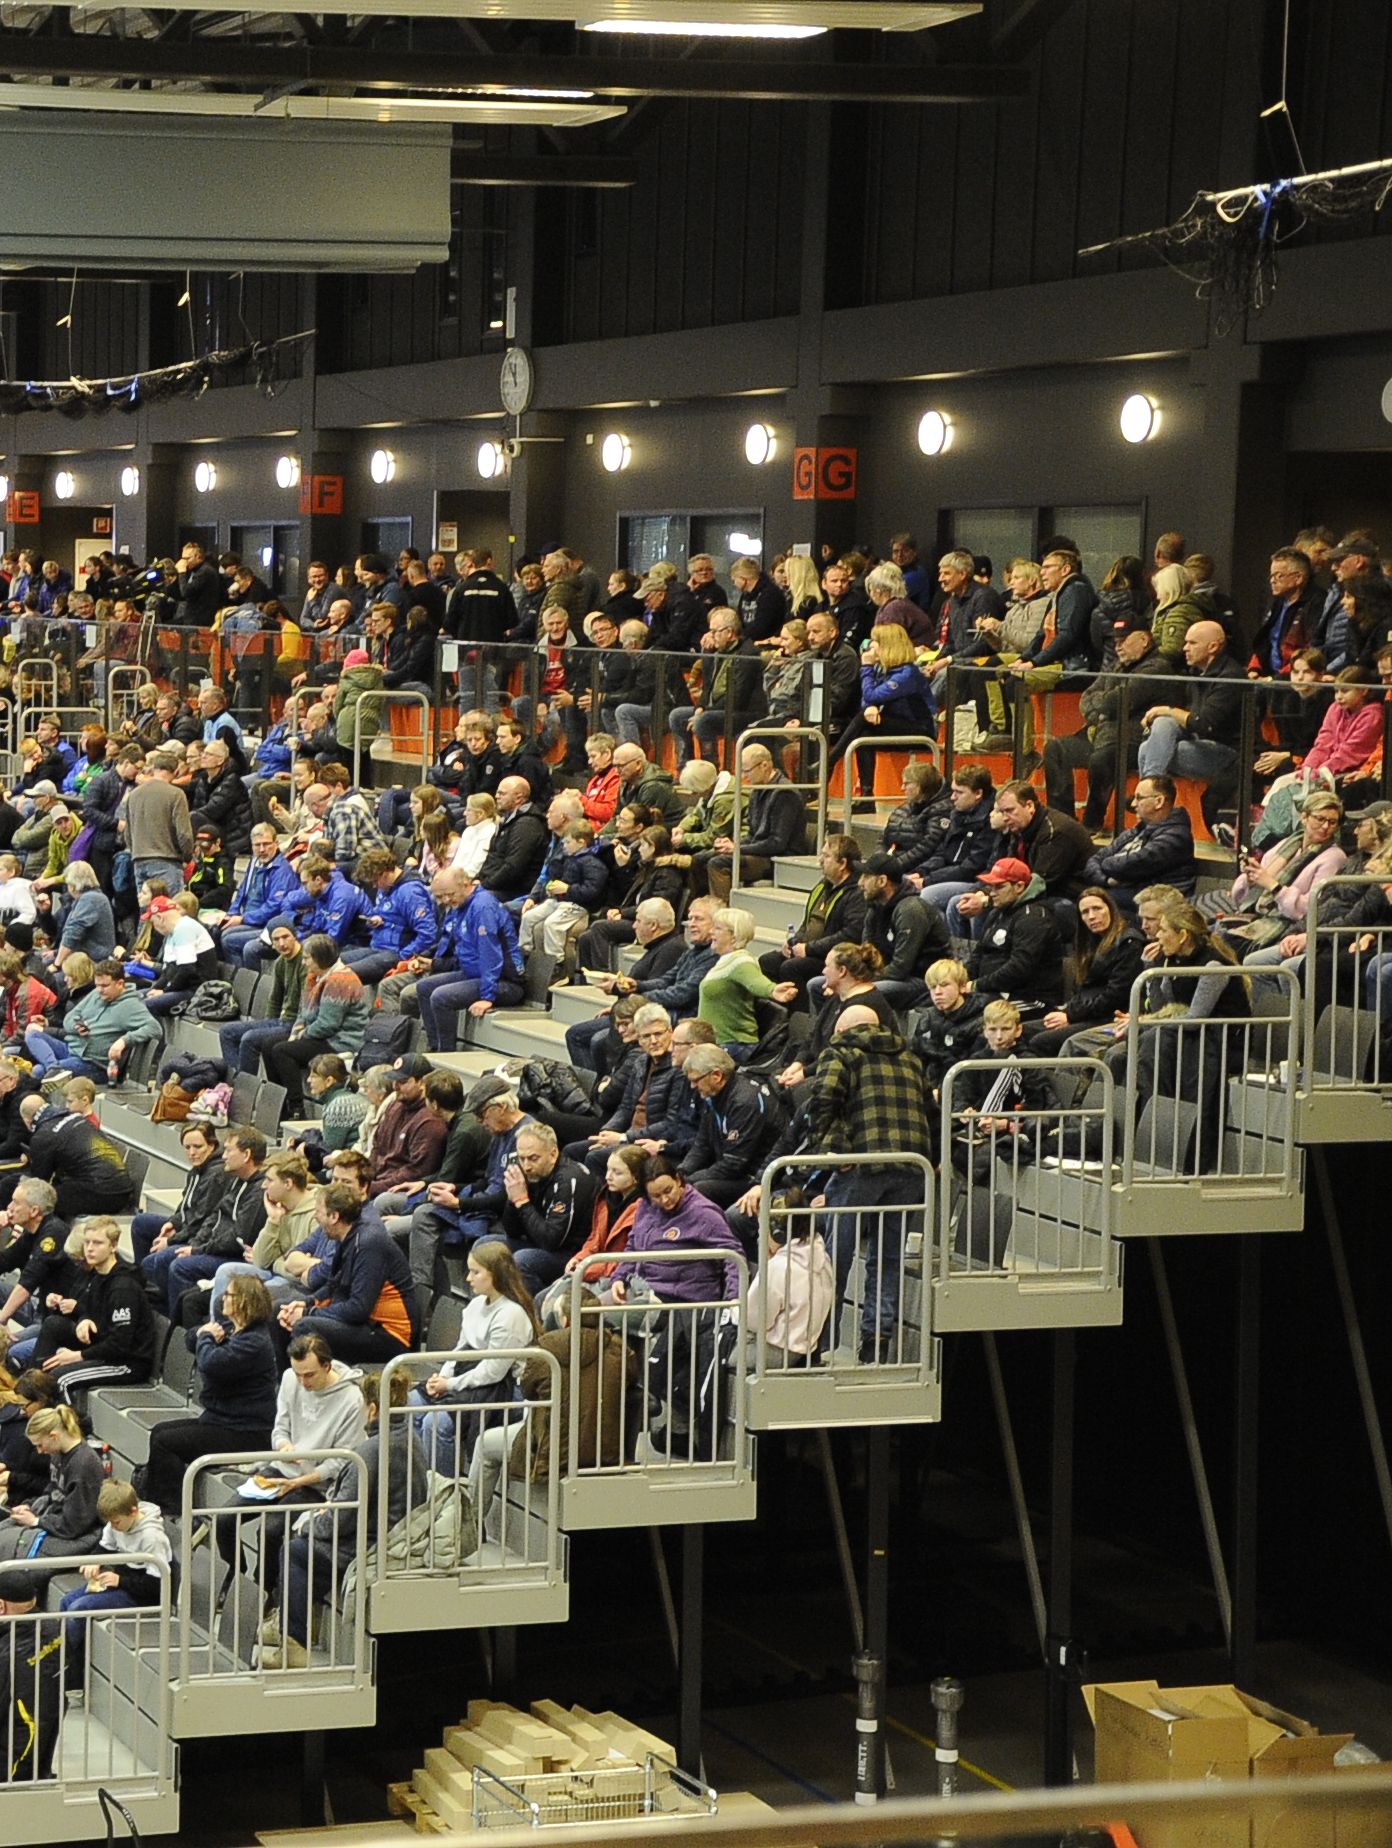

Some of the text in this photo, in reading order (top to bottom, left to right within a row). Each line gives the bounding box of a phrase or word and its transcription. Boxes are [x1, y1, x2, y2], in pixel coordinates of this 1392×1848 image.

[798, 453, 813, 491] G
[823, 454, 853, 491] G
[19, 495, 35, 518] E
[319, 480, 337, 508] F
